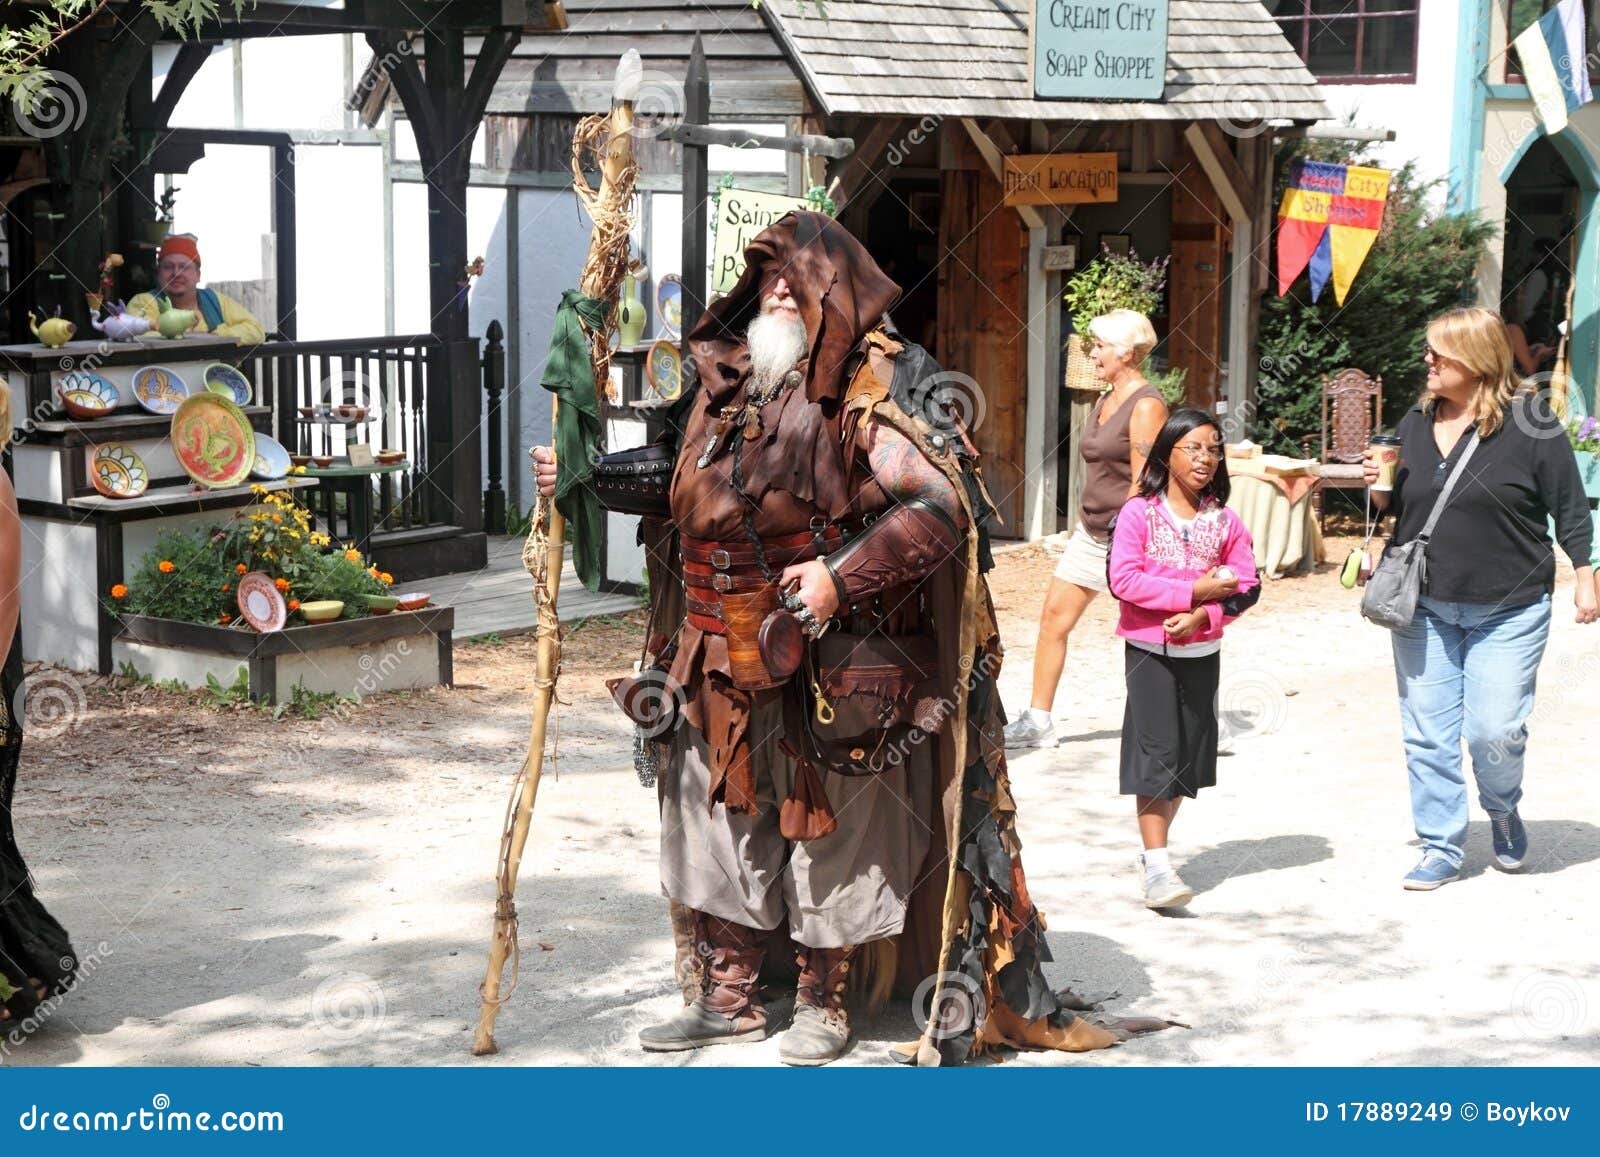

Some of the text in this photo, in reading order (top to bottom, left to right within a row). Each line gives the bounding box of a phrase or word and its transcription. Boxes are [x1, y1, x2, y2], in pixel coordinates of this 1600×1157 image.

[1046, 49, 1156, 79] SOAP SHOPPE
[1350, 176, 1385, 197] City
